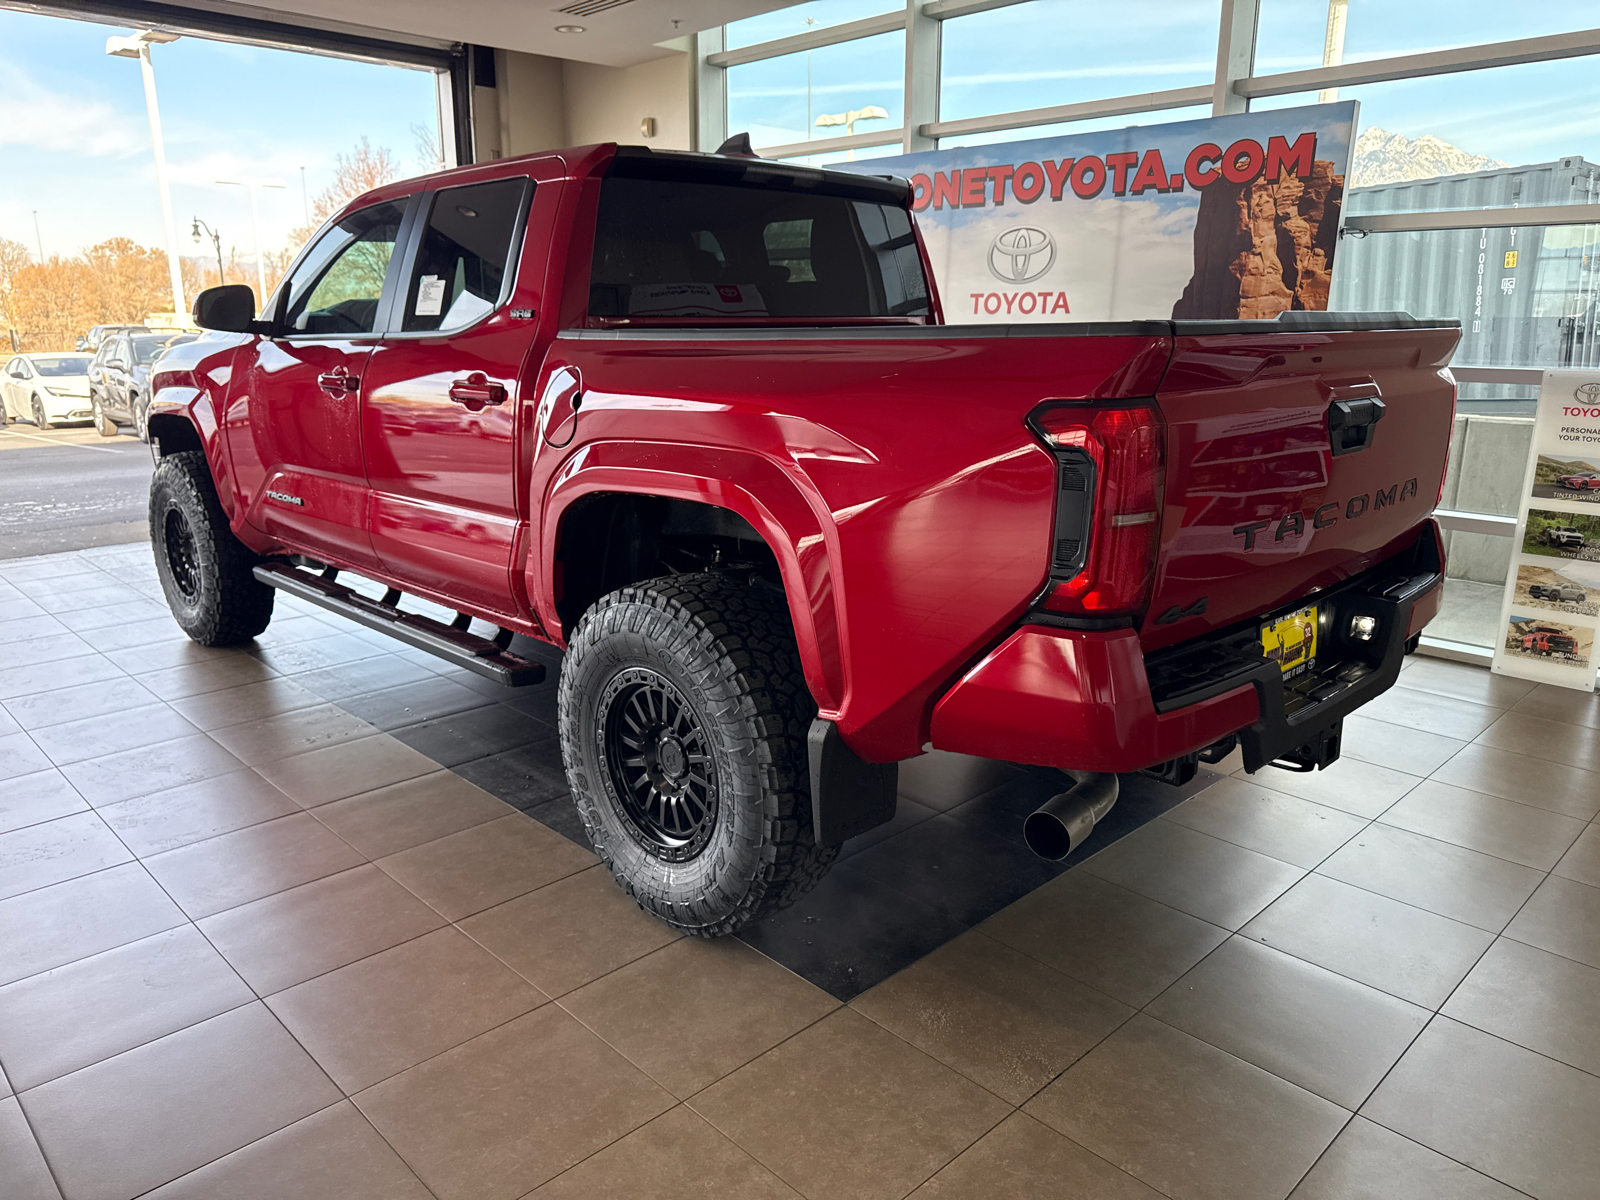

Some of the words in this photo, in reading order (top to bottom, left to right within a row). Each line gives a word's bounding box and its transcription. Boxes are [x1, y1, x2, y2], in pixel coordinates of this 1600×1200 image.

[970, 291, 1070, 315] TOYOTA
[266, 490, 304, 506] TACOMA
[1233, 477, 1417, 552] TACOMA
[1304, 627, 1312, 637] 32
